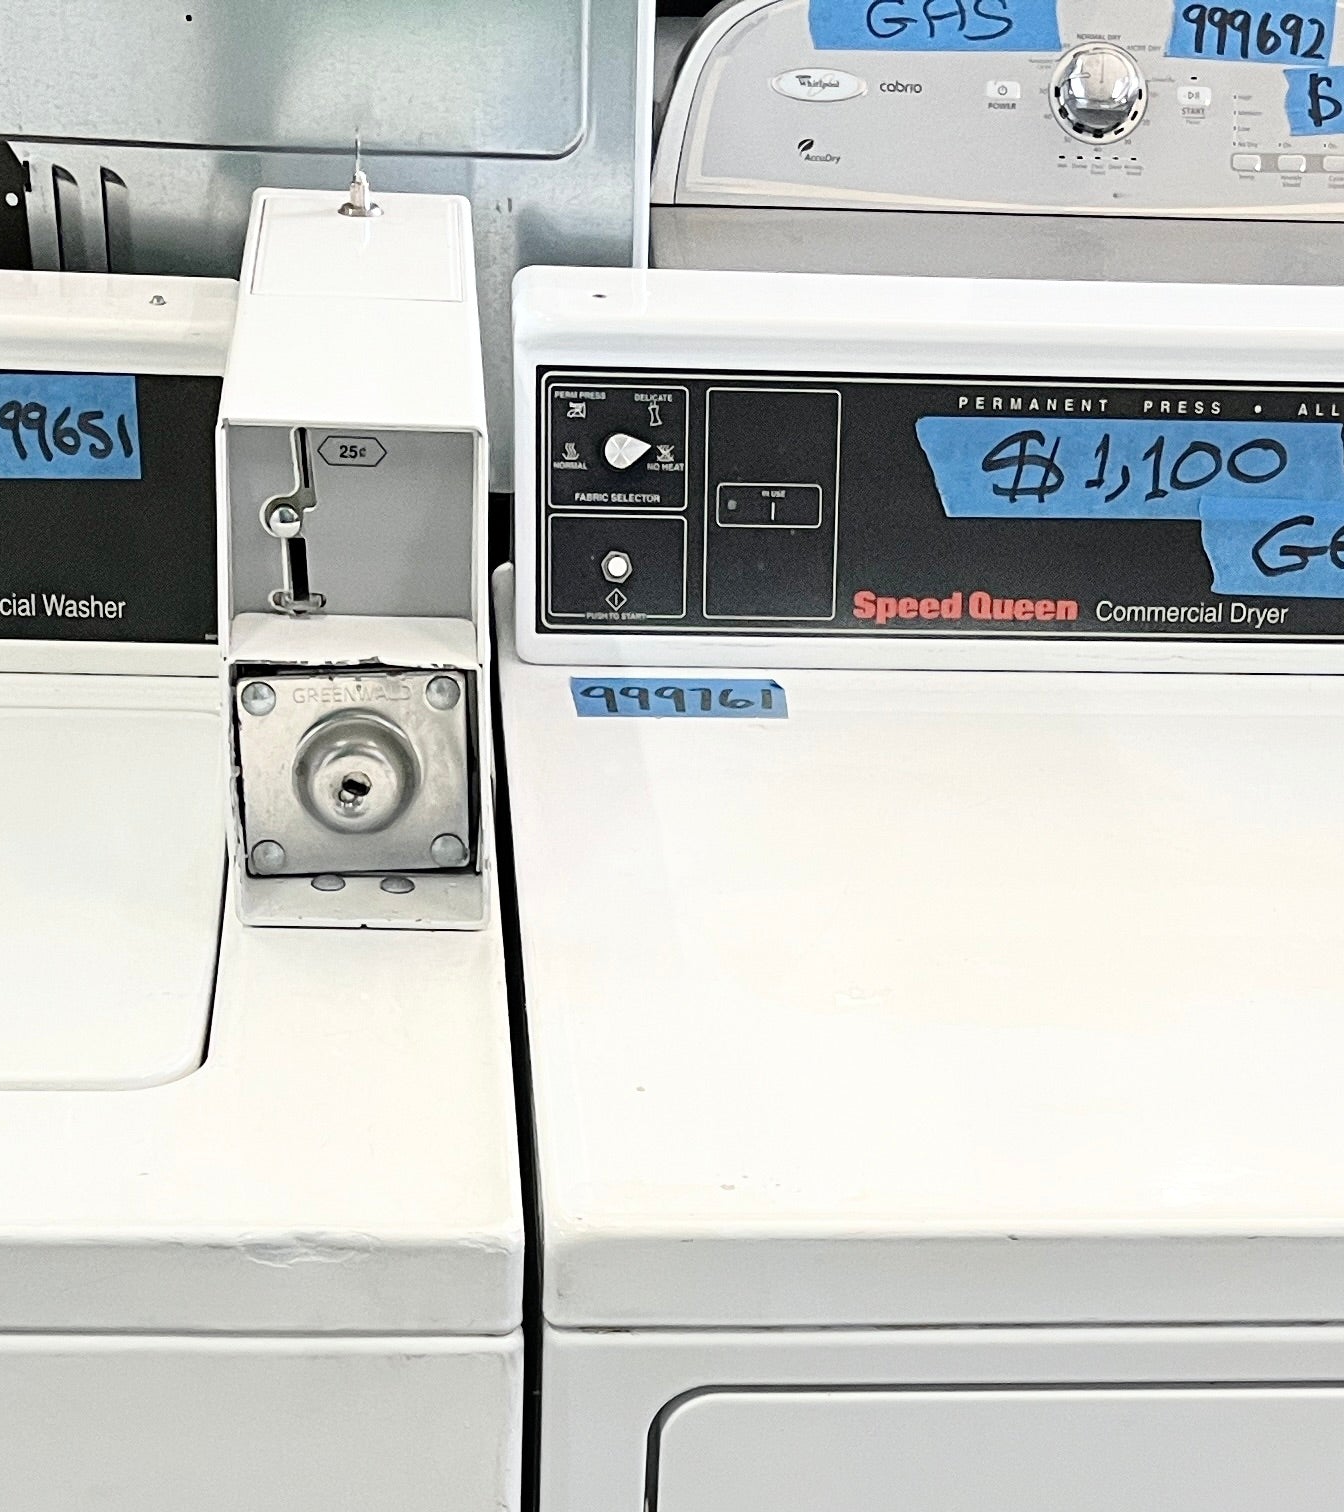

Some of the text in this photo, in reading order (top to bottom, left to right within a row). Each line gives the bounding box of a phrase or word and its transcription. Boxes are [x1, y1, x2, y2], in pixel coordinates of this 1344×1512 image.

[866, 0, 1013, 41] GAS
[1182, 4, 1325, 59] 999692
[795, 75, 840, 88] Whirlpool
[879, 81, 923, 94] cabrio
[1181, 107, 1205, 115] START
[805, 153, 841, 164] AccuDry
[554, 391, 606, 400] PERM PRESS
[634, 393, 672, 402] DELICATE
[958, 396, 1110, 412] PERMANENT
[1144, 400, 1223, 415] PRESS
[1298, 403, 1341, 416] ALL
[553, 462, 587, 470] NORMAL
[662, 463, 684, 471] HEAT
[981, 430, 1287, 503] $1,100
[575, 493, 660, 502] FABRIC SELECTOR
[42, 594, 126, 619] Washer
[853, 590, 1288, 628] Speed Queen Commercial Dryer
[293, 685, 412, 704] GREENWALD
[580, 687, 774, 713] 999761
